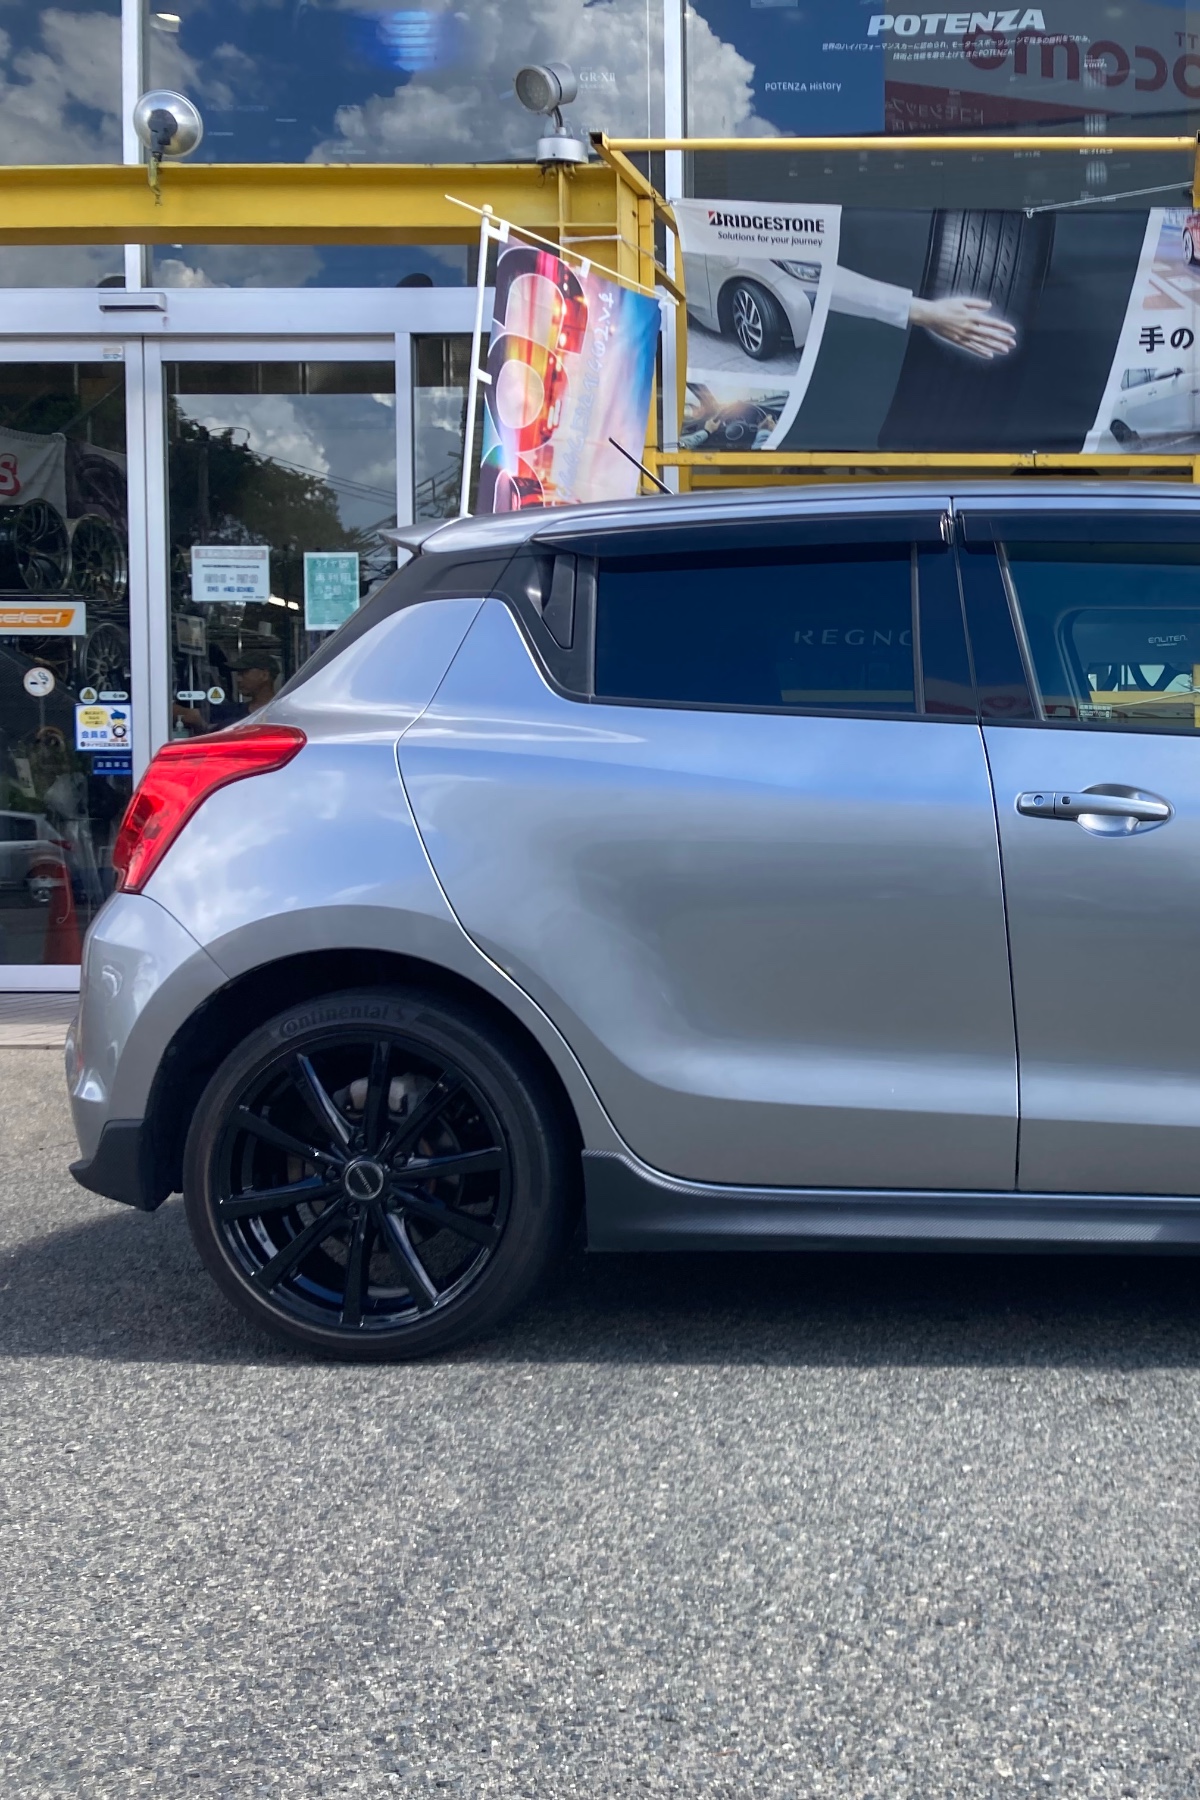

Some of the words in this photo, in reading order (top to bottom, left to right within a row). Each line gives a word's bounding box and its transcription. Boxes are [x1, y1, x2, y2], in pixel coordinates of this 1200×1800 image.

[867, 8, 1046, 36] POTENZA
[764, 81, 807, 91] POTENZA
[809, 81, 842, 93] History
[708, 211, 825, 234] BRIDGESTONE
[717, 231, 755, 243] Solutions
[757, 233, 769, 243] for
[770, 235, 789, 246] your
[791, 235, 823, 248] journey
[279, 1004, 389, 1038] Continental
